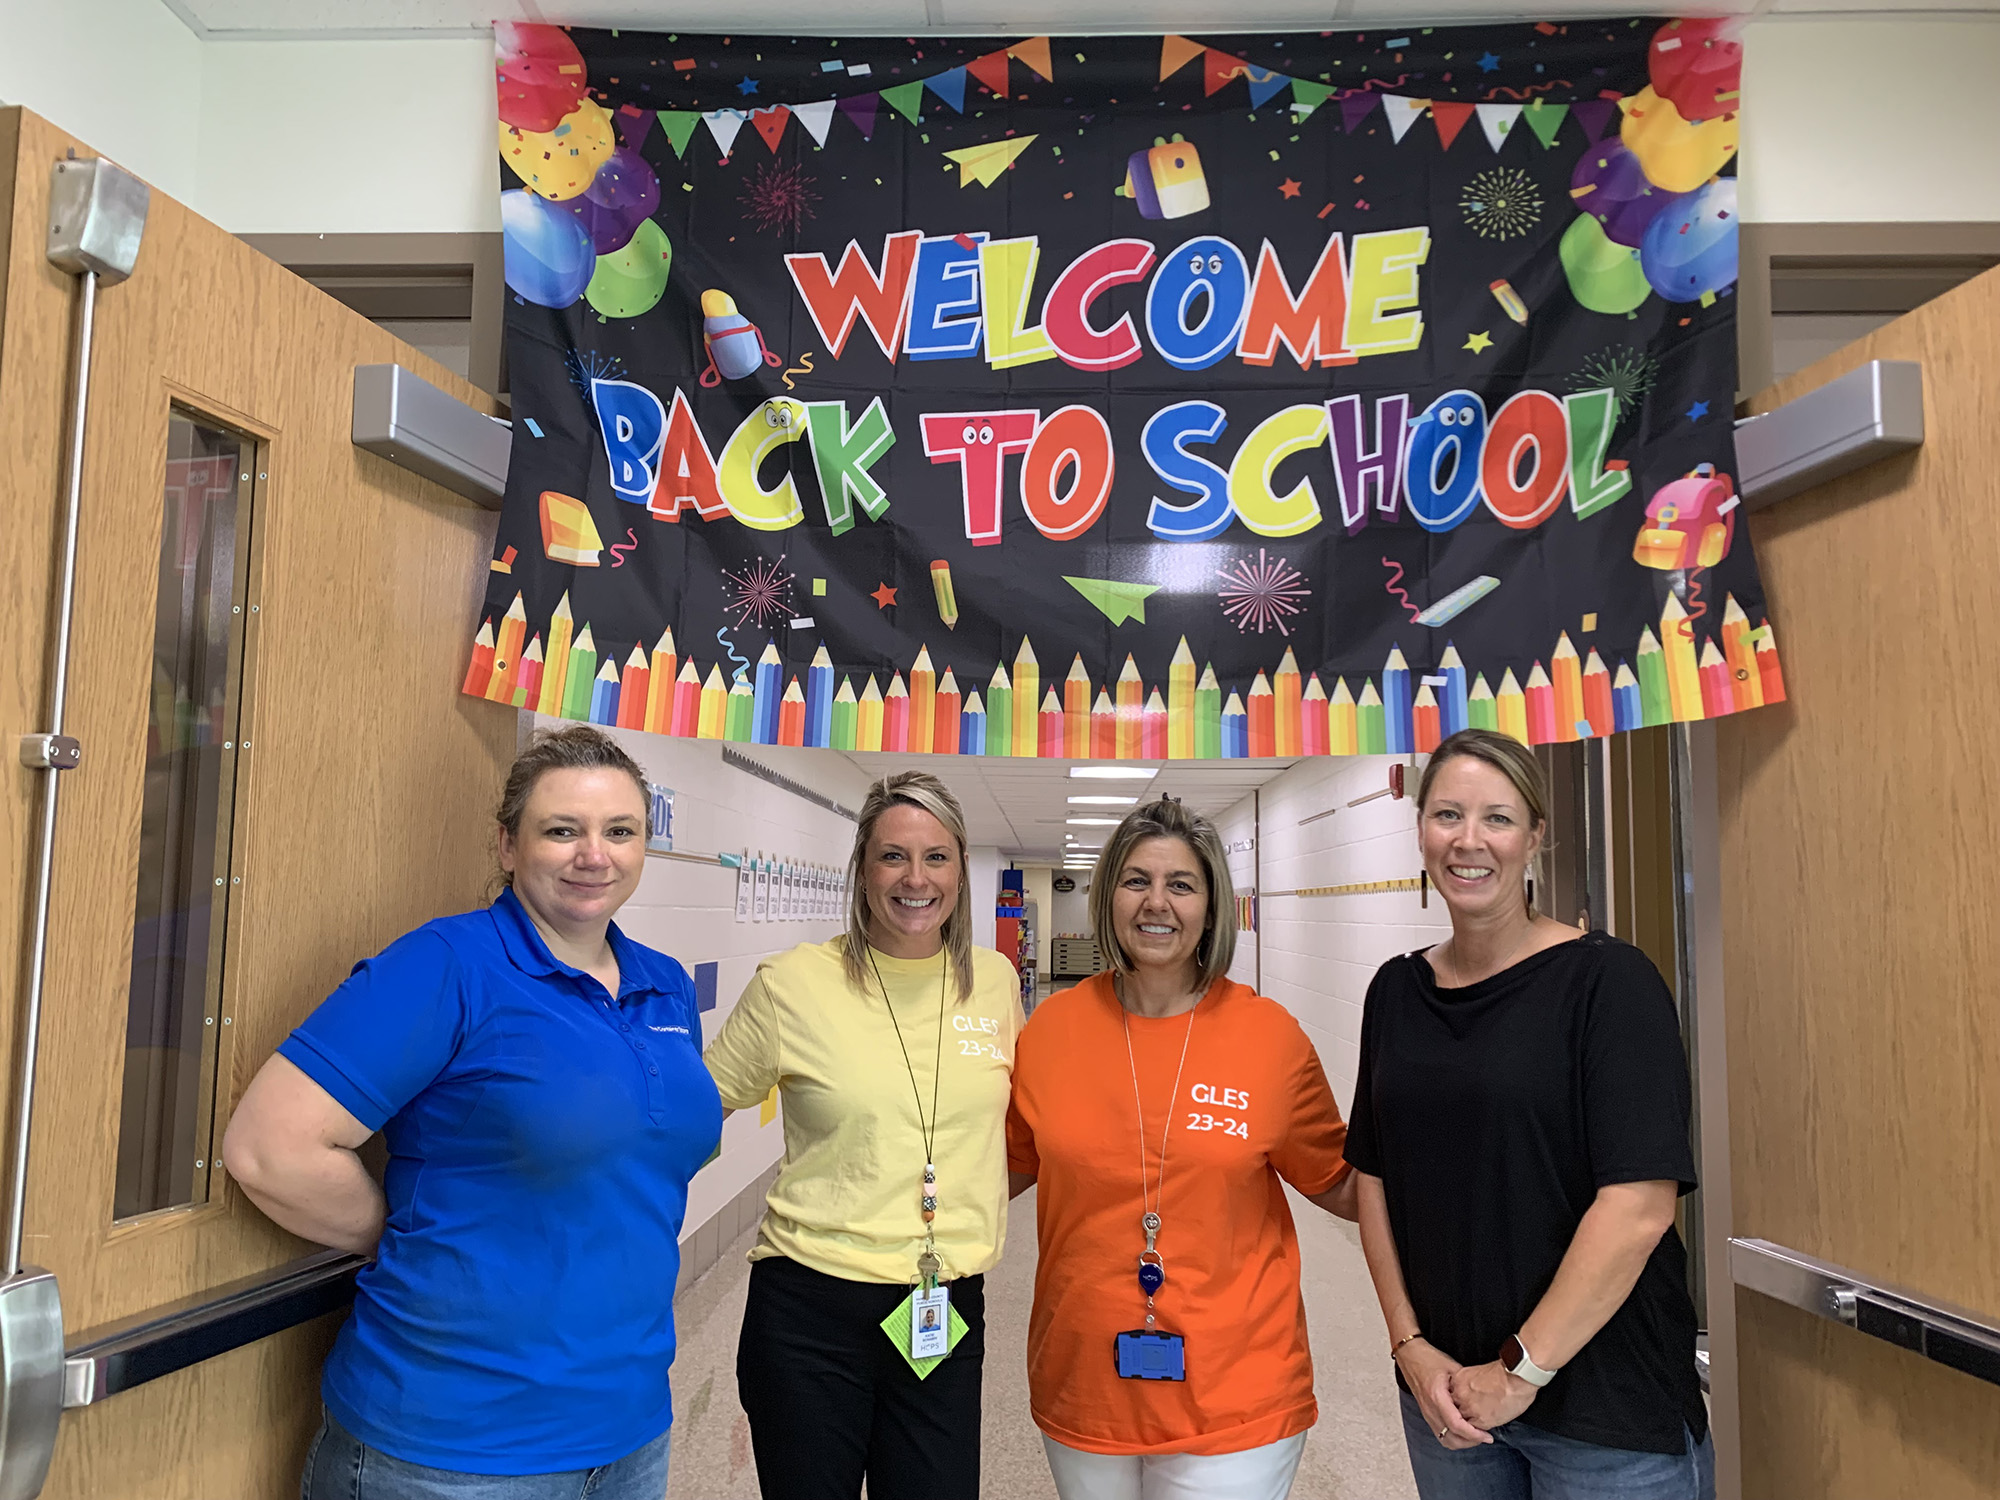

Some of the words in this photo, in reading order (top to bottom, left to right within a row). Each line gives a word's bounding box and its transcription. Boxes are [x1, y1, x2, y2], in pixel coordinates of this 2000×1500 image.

[784, 227, 1431, 371] WELCOME
[591, 379, 896, 536] BACK
[919, 404, 1115, 546] TO
[1141, 388, 1632, 543] SCHOOL
[952, 1015, 999, 1036] GLES
[957, 1040, 1007, 1061] 23-24
[1191, 1083, 1250, 1110] GLES
[1186, 1113, 1249, 1140] 23-24
